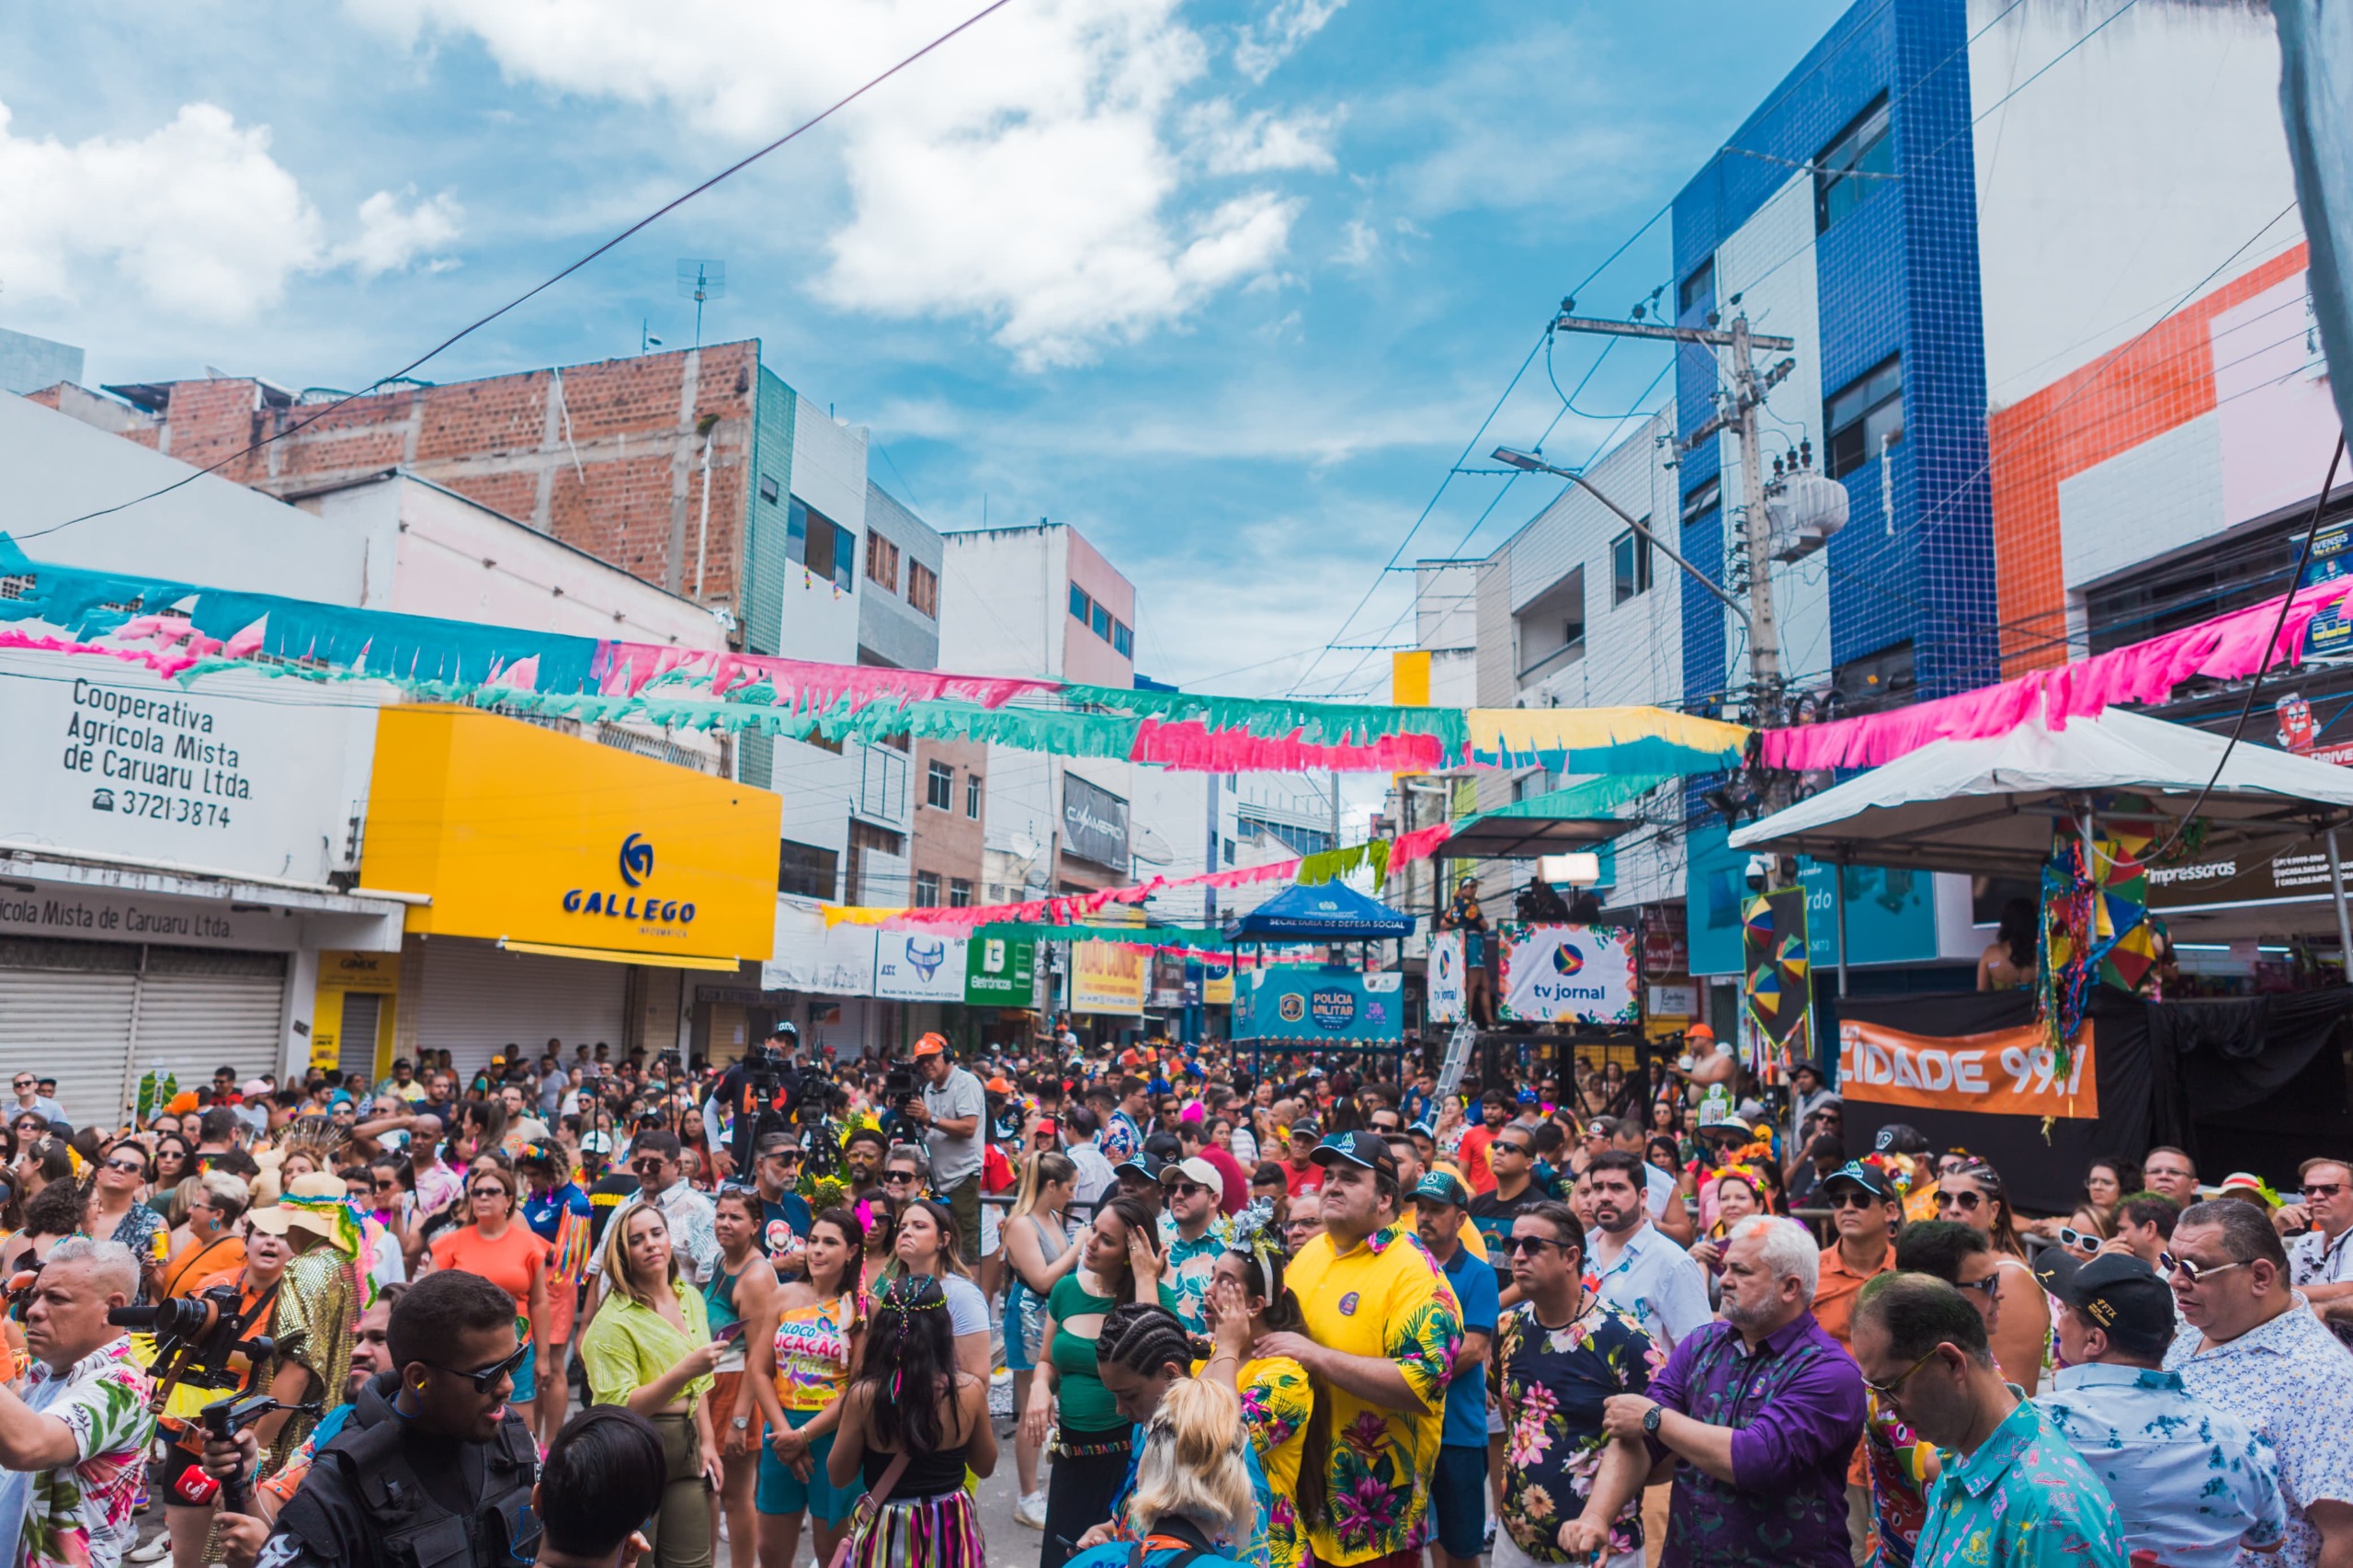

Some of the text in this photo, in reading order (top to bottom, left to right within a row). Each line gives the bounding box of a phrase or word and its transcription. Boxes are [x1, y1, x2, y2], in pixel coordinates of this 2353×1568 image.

[74, 677, 213, 733] Cooperativa
[67, 711, 239, 768] Agrícola Mista
[63, 744, 253, 800] de Caruaru Ltda.
[2149, 861, 2236, 884] Impressoras
[40, 901, 92, 928] Mista
[98, 906, 119, 930] de
[126, 907, 188, 936] Caruaru
[563, 890, 696, 924] GALLEGO
[1269, 918, 1323, 926] SECRETARIA
[1337, 920, 1370, 928] DEFESA
[1373, 920, 1404, 929] SOCIAL
[1313, 993, 1353, 1005] POLÍCIA
[1534, 983, 1605, 1002] tv jornal
[1313, 1005, 1354, 1016] MILITAR
[1840, 1040, 1990, 1093] CIDADE
[779, 1323, 816, 1337] BLOCO
[775, 1335, 841, 1358] UCAÇÃO
